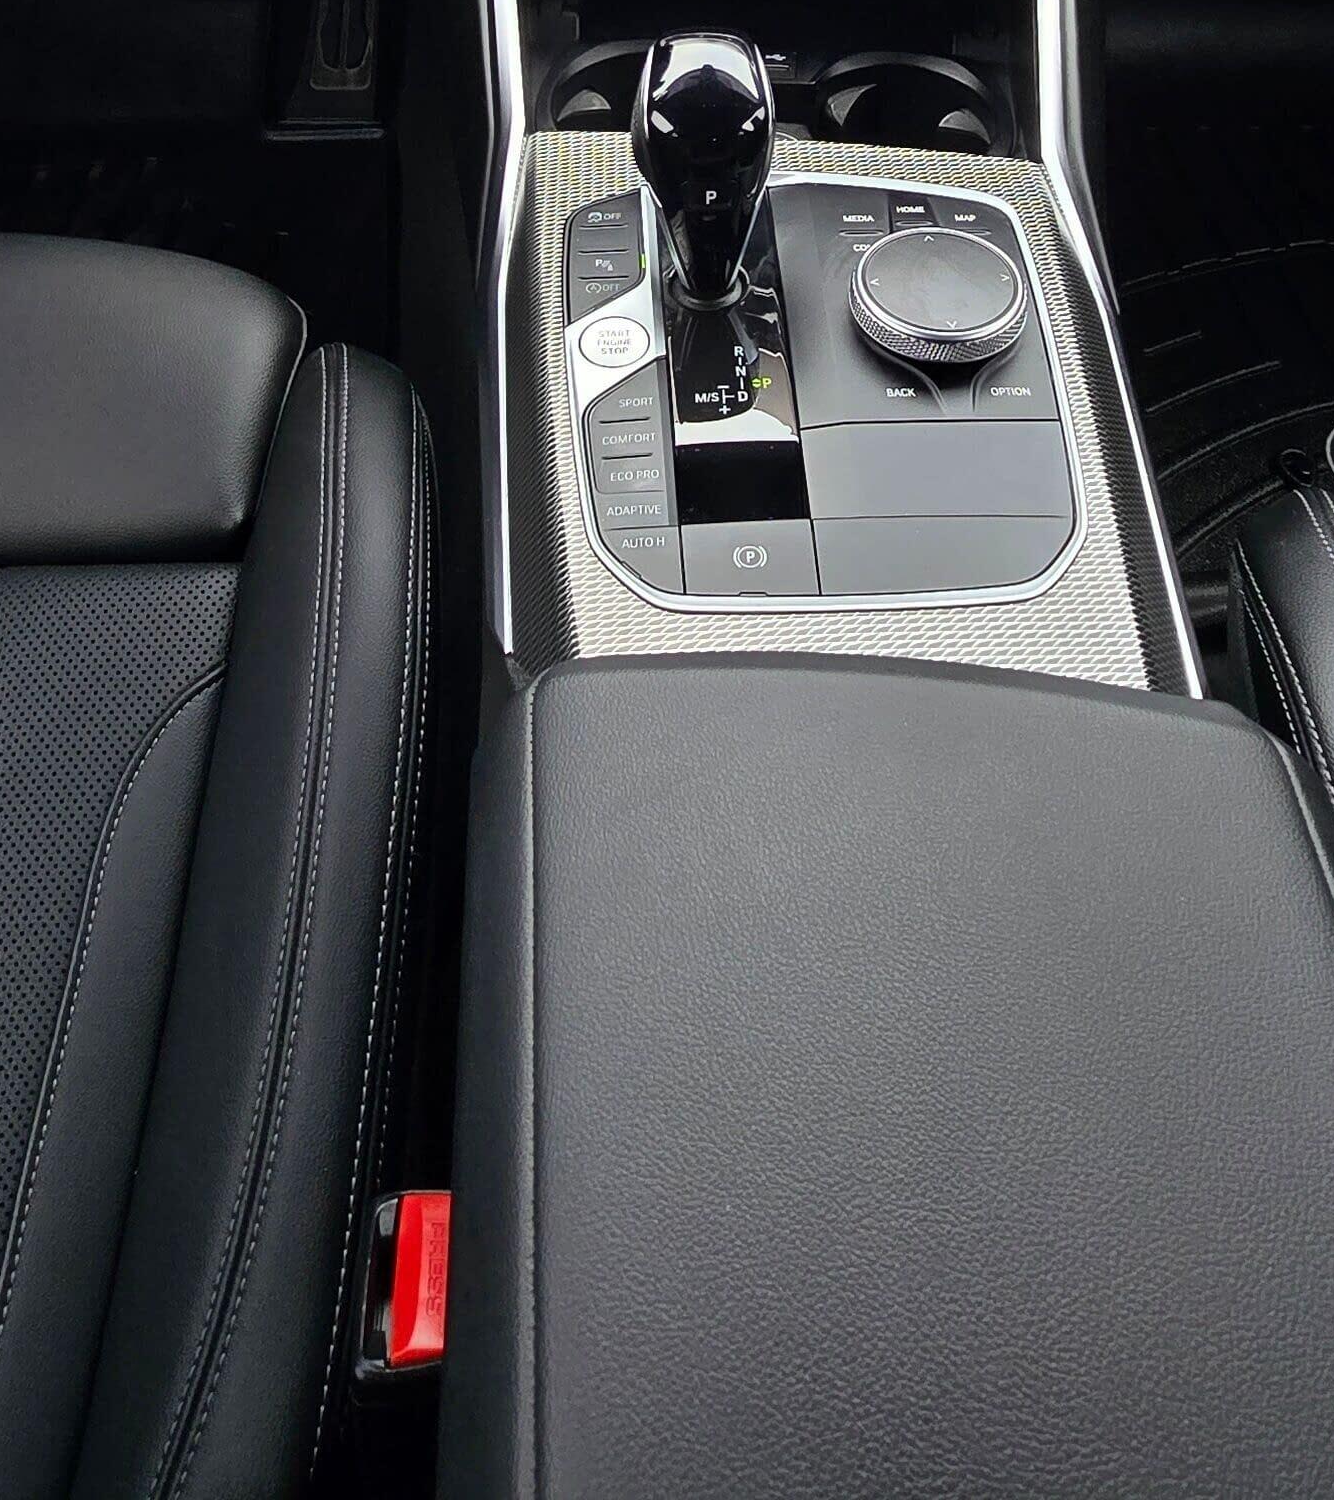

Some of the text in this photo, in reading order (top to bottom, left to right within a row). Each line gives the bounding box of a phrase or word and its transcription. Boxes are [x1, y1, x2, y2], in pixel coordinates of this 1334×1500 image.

[705, 190, 717, 204] P
[955, 214, 976, 222] MAP
[853, 244, 870, 252] CO
[602, 284, 620, 292] OFF
[598, 329, 630, 338] START
[601, 347, 629, 355] STOP
[734, 346, 744, 357] R
[735, 366, 746, 377] N
[762, 378, 772, 389] P
[694, 392, 720, 403] M/S
[737, 391, 749, 402] D
[886, 387, 916, 397] BACK
[990, 387, 1031, 397] OPTION
[619, 396, 654, 409] SPORT
[602, 432, 656, 446] COMFORT
[610, 469, 660, 482] ECO PRO
[606, 504, 662, 517] ADAPTIVE
[621, 536, 665, 549] AUTO H
[426, 1222, 447, 1316] PRESS
